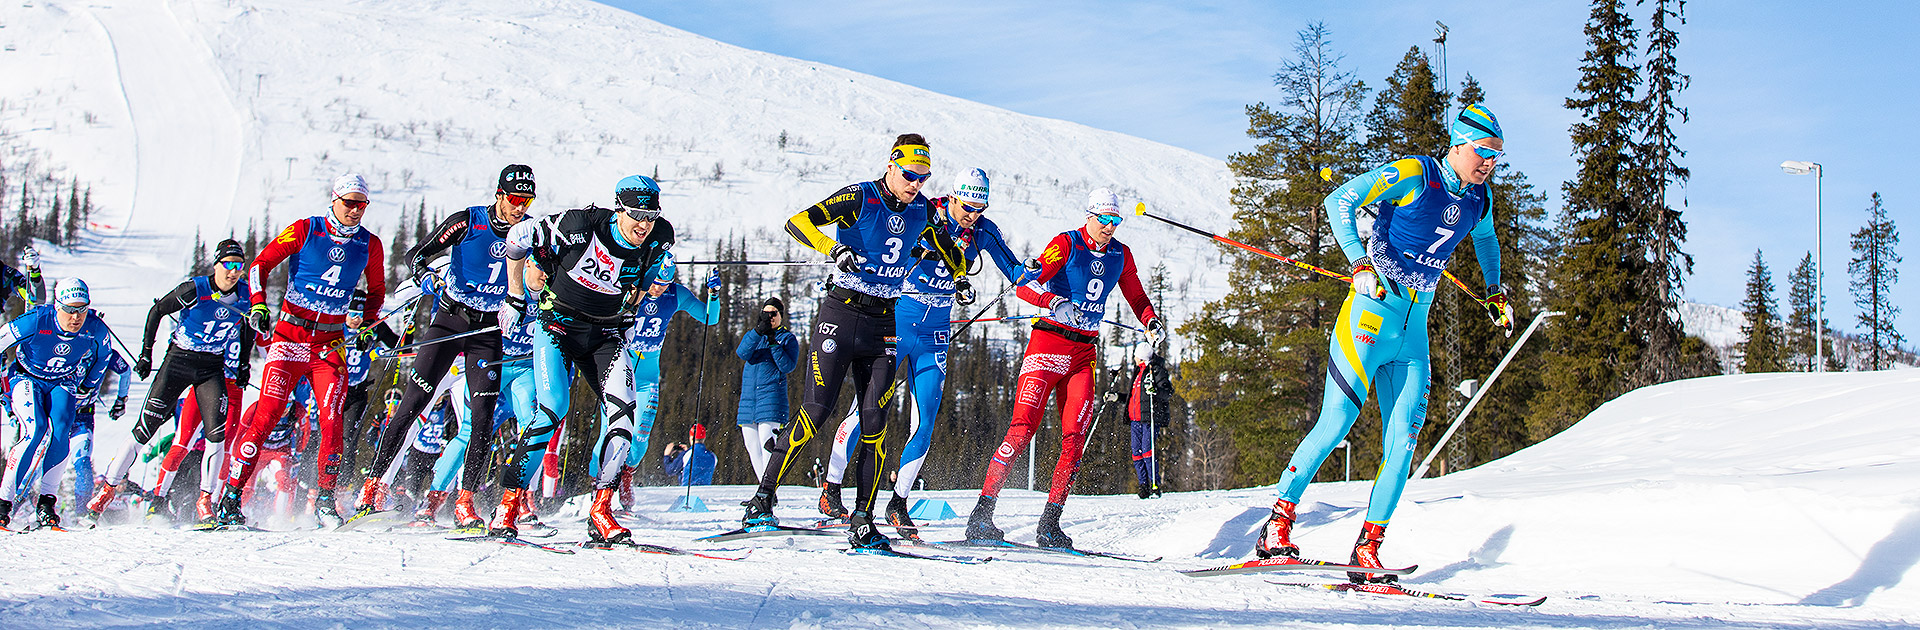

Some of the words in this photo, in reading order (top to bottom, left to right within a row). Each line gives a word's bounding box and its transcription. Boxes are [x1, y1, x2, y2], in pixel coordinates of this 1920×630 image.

[825, 193, 856, 206] TRIMTEX
[881, 237, 904, 264] 3
[1426, 226, 1455, 254] 7
[320, 264, 342, 286] 4
[488, 261, 504, 284] 1
[315, 285, 347, 299] LKAB
[476, 283, 506, 295] LKAB
[1085, 278, 1105, 301] 9
[203, 320, 233, 339] 12
[635, 316, 664, 333] 13
[811, 350, 826, 388] TRIMTEX
[413, 371, 434, 394] LKAB
[422, 422, 444, 438] 25
